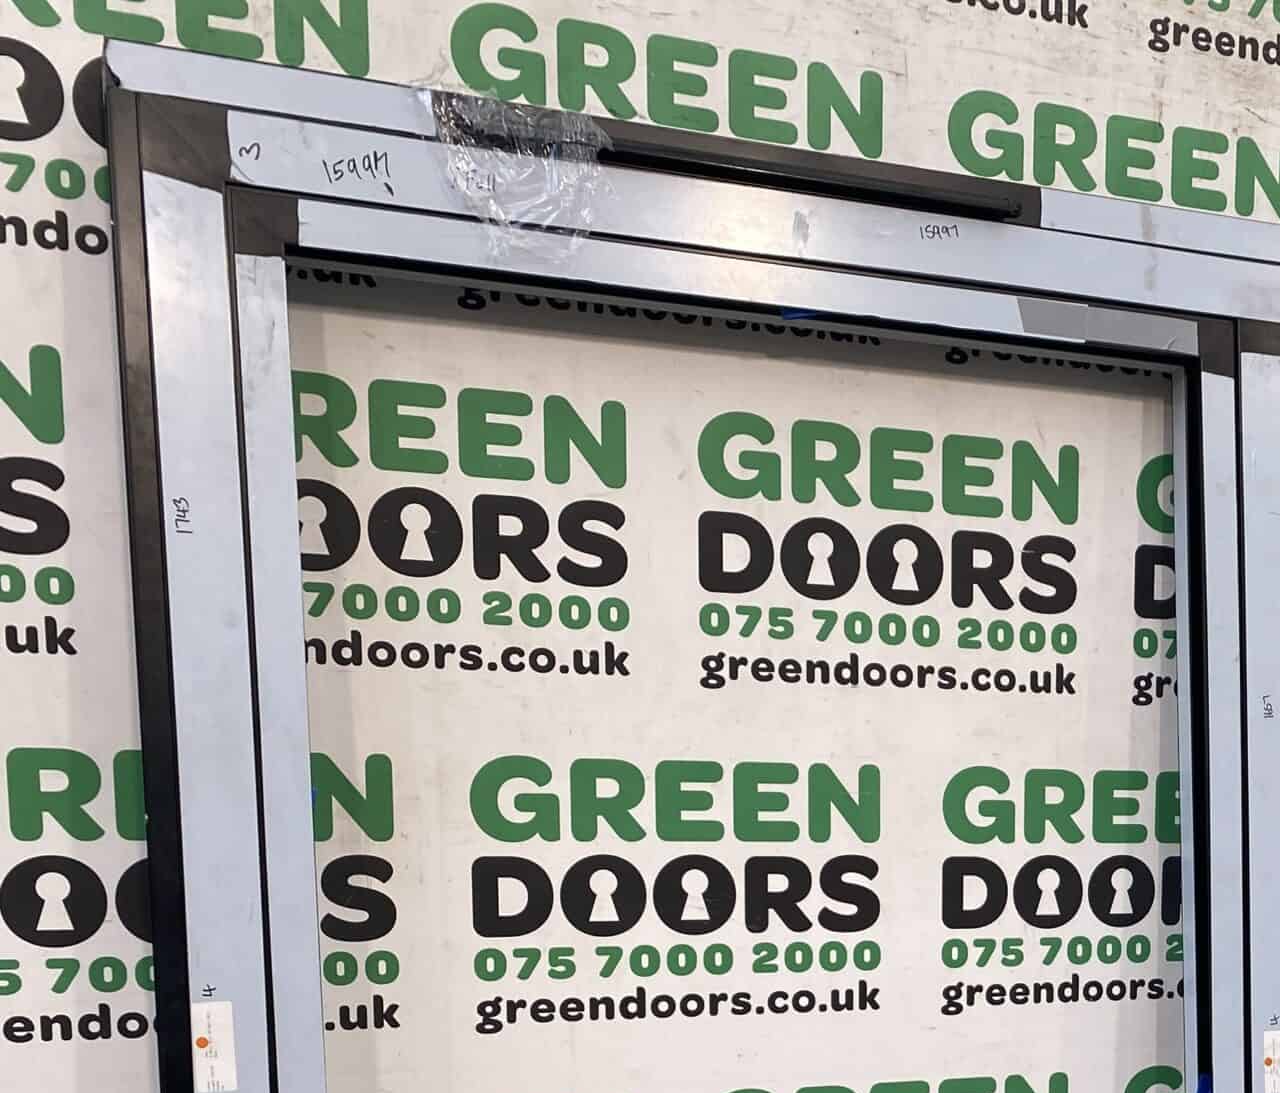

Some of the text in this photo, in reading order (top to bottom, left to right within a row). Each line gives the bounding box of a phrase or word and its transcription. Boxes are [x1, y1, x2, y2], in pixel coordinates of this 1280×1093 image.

[450, 3, 881, 157] GREEN
[697, 411, 1080, 524] GREEN
[698, 510, 1077, 614] DOORS
[484, 592, 629, 631] 2000
[699, 603, 1076, 654] 075 7000 2000
[700, 652, 1075, 694] greendoors.co.uk
[469, 755, 881, 842] GREEN
[470, 854, 880, 937] DOORS
[474, 941, 880, 981] 075 7000 2000
[942, 935, 1150, 968] 075 7000
[476, 980, 879, 1034] greendoors.co.uk
